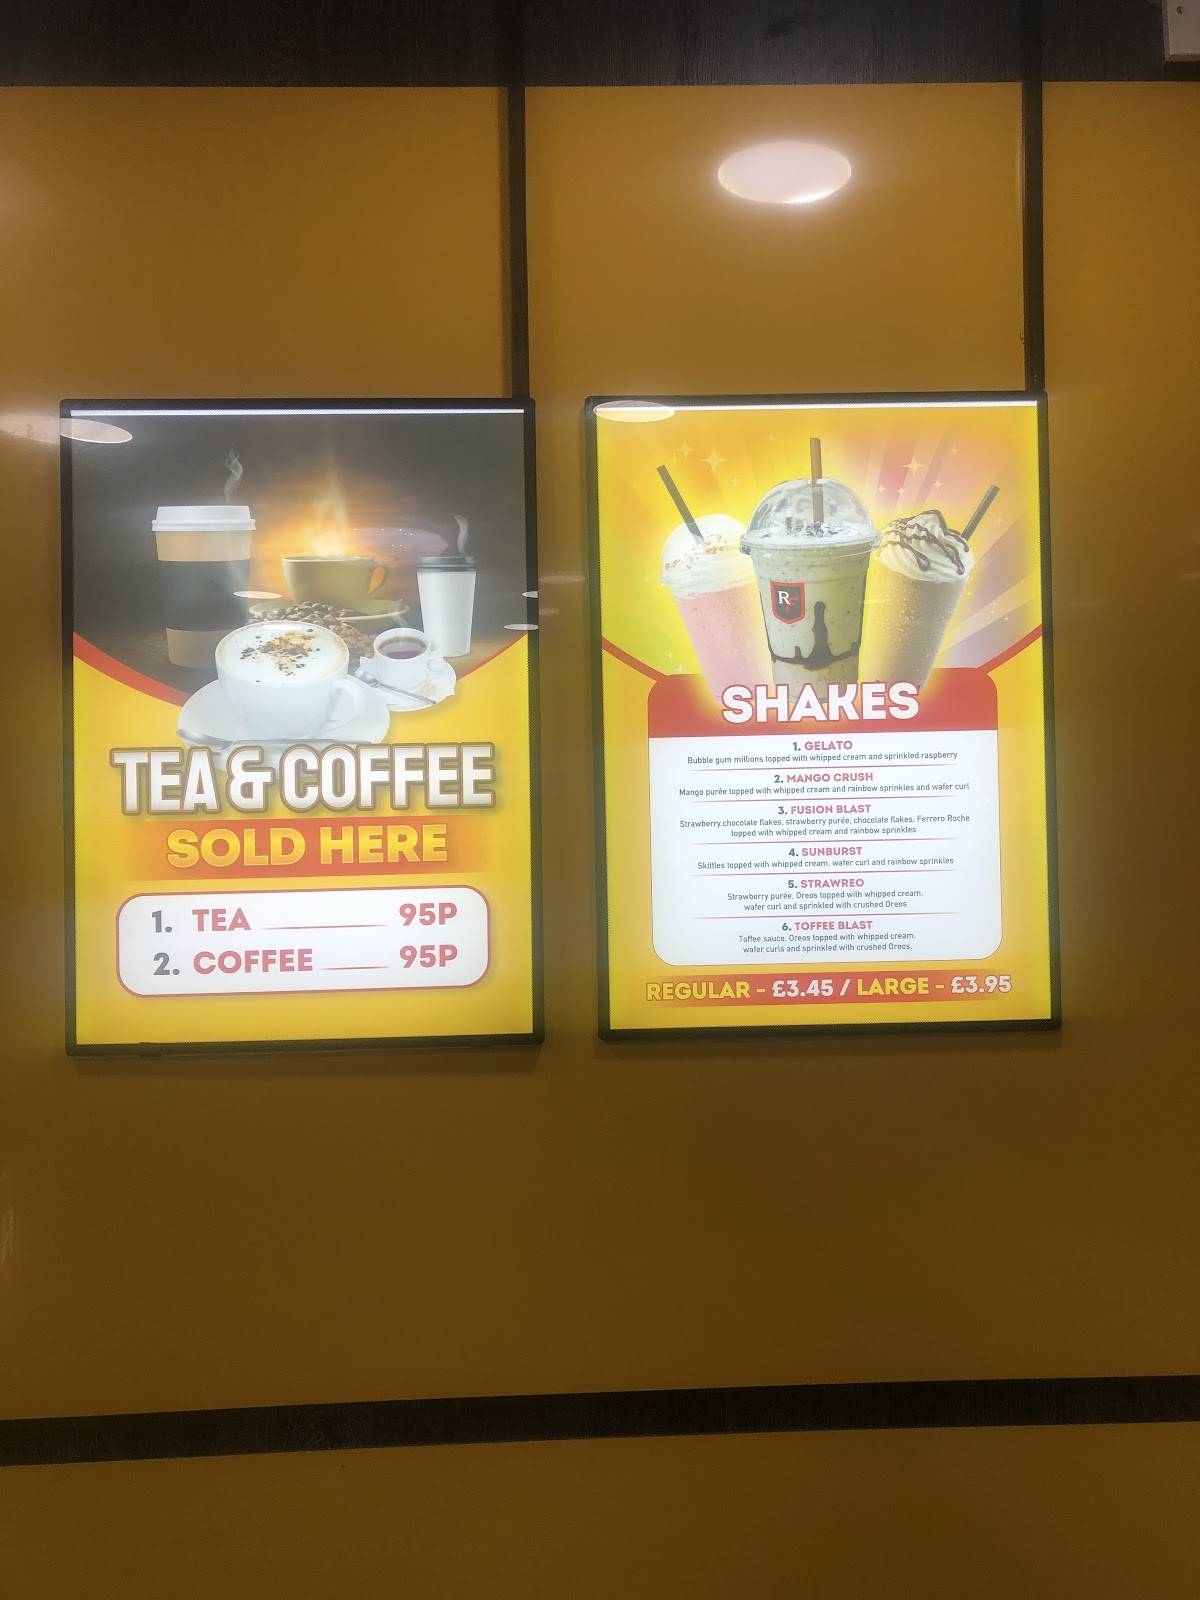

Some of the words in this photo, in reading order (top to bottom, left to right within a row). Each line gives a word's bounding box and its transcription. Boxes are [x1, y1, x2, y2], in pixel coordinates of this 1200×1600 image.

[722, 682, 920, 724] SHAKES
[793, 742, 801, 751] 1.
[804, 740, 853, 751] GELATO
[688, 756, 713, 764] Bubble
[765, 755, 790, 765] topped
[810, 753, 840, 762] whipped
[884, 752, 919, 761] sprinkled
[921, 752, 957, 760] raspberry
[112, 748, 220, 813] TEA
[228, 748, 273, 811] &
[282, 744, 493, 810] COFFEE
[774, 775, 783, 783] 2.
[787, 774, 830, 782] MANGO
[834, 772, 873, 781] CRUSH
[680, 789, 703, 797] Mango
[706, 788, 727, 796] purée
[729, 788, 753, 796] topped
[774, 786, 804, 795] whipped
[832, 785, 845, 793] and
[880, 784, 914, 793] sprinkles
[916, 783, 930, 791] and
[955, 782, 970, 790] curl
[778, 806, 787, 815] 3.
[791, 805, 833, 814] FUSION
[836, 804, 871, 813] BLAST
[786, 817, 826, 826] strawberry
[854, 816, 888, 824] chocolate
[731, 829, 756, 838] topped
[776, 828, 807, 837] whipped
[850, 826, 880, 834] rainbow
[882, 826, 917, 835] sprinkles
[167, 828, 305, 868] SOLD
[319, 824, 448, 864] HERE
[789, 848, 798, 857] 4.
[802, 847, 862, 856] SUNBURST
[698, 861, 725, 869] Skittles
[727, 861, 752, 870] topped
[772, 860, 803, 869] whipped
[888, 857, 917, 865] rainbow
[920, 857, 954, 866] sprinkles
[788, 880, 798, 889] 5.
[800, 879, 865, 888] STRAWREO
[728, 893, 768, 901] Strawberry
[819, 891, 845, 900] topped
[847, 890, 862, 898] with
[864, 890, 896, 899] whipped
[744, 903, 765, 911] wafer
[783, 902, 797, 910] and
[799, 902, 834, 911] sprinkled
[885, 900, 907, 908] Oreos
[152, 910, 172, 933] 1.
[192, 908, 251, 931] TEA
[399, 902, 457, 926] 95P
[782, 922, 792, 931] 6.
[794, 921, 835, 931] TOFFEE
[838, 921, 872, 930] BLAST
[739, 935, 761, 943] Toffee
[789, 934, 811, 942] Oreos
[812, 933, 838, 942] topped
[857, 932, 889, 941] whipped
[743, 945, 764, 953] wafer
[787, 944, 801, 952] and
[802, 944, 837, 953] sprinkled
[856, 943, 886, 951] crushed
[153, 952, 180, 976] 2.
[193, 948, 313, 975] COFFEE
[399, 944, 458, 969] 95P
[646, 981, 751, 1001] REGULAR
[771, 979, 834, 998] £3.45
[839, 979, 850, 996] /
[857, 977, 929, 996] LARGE
[951, 975, 1012, 994] £3.95
